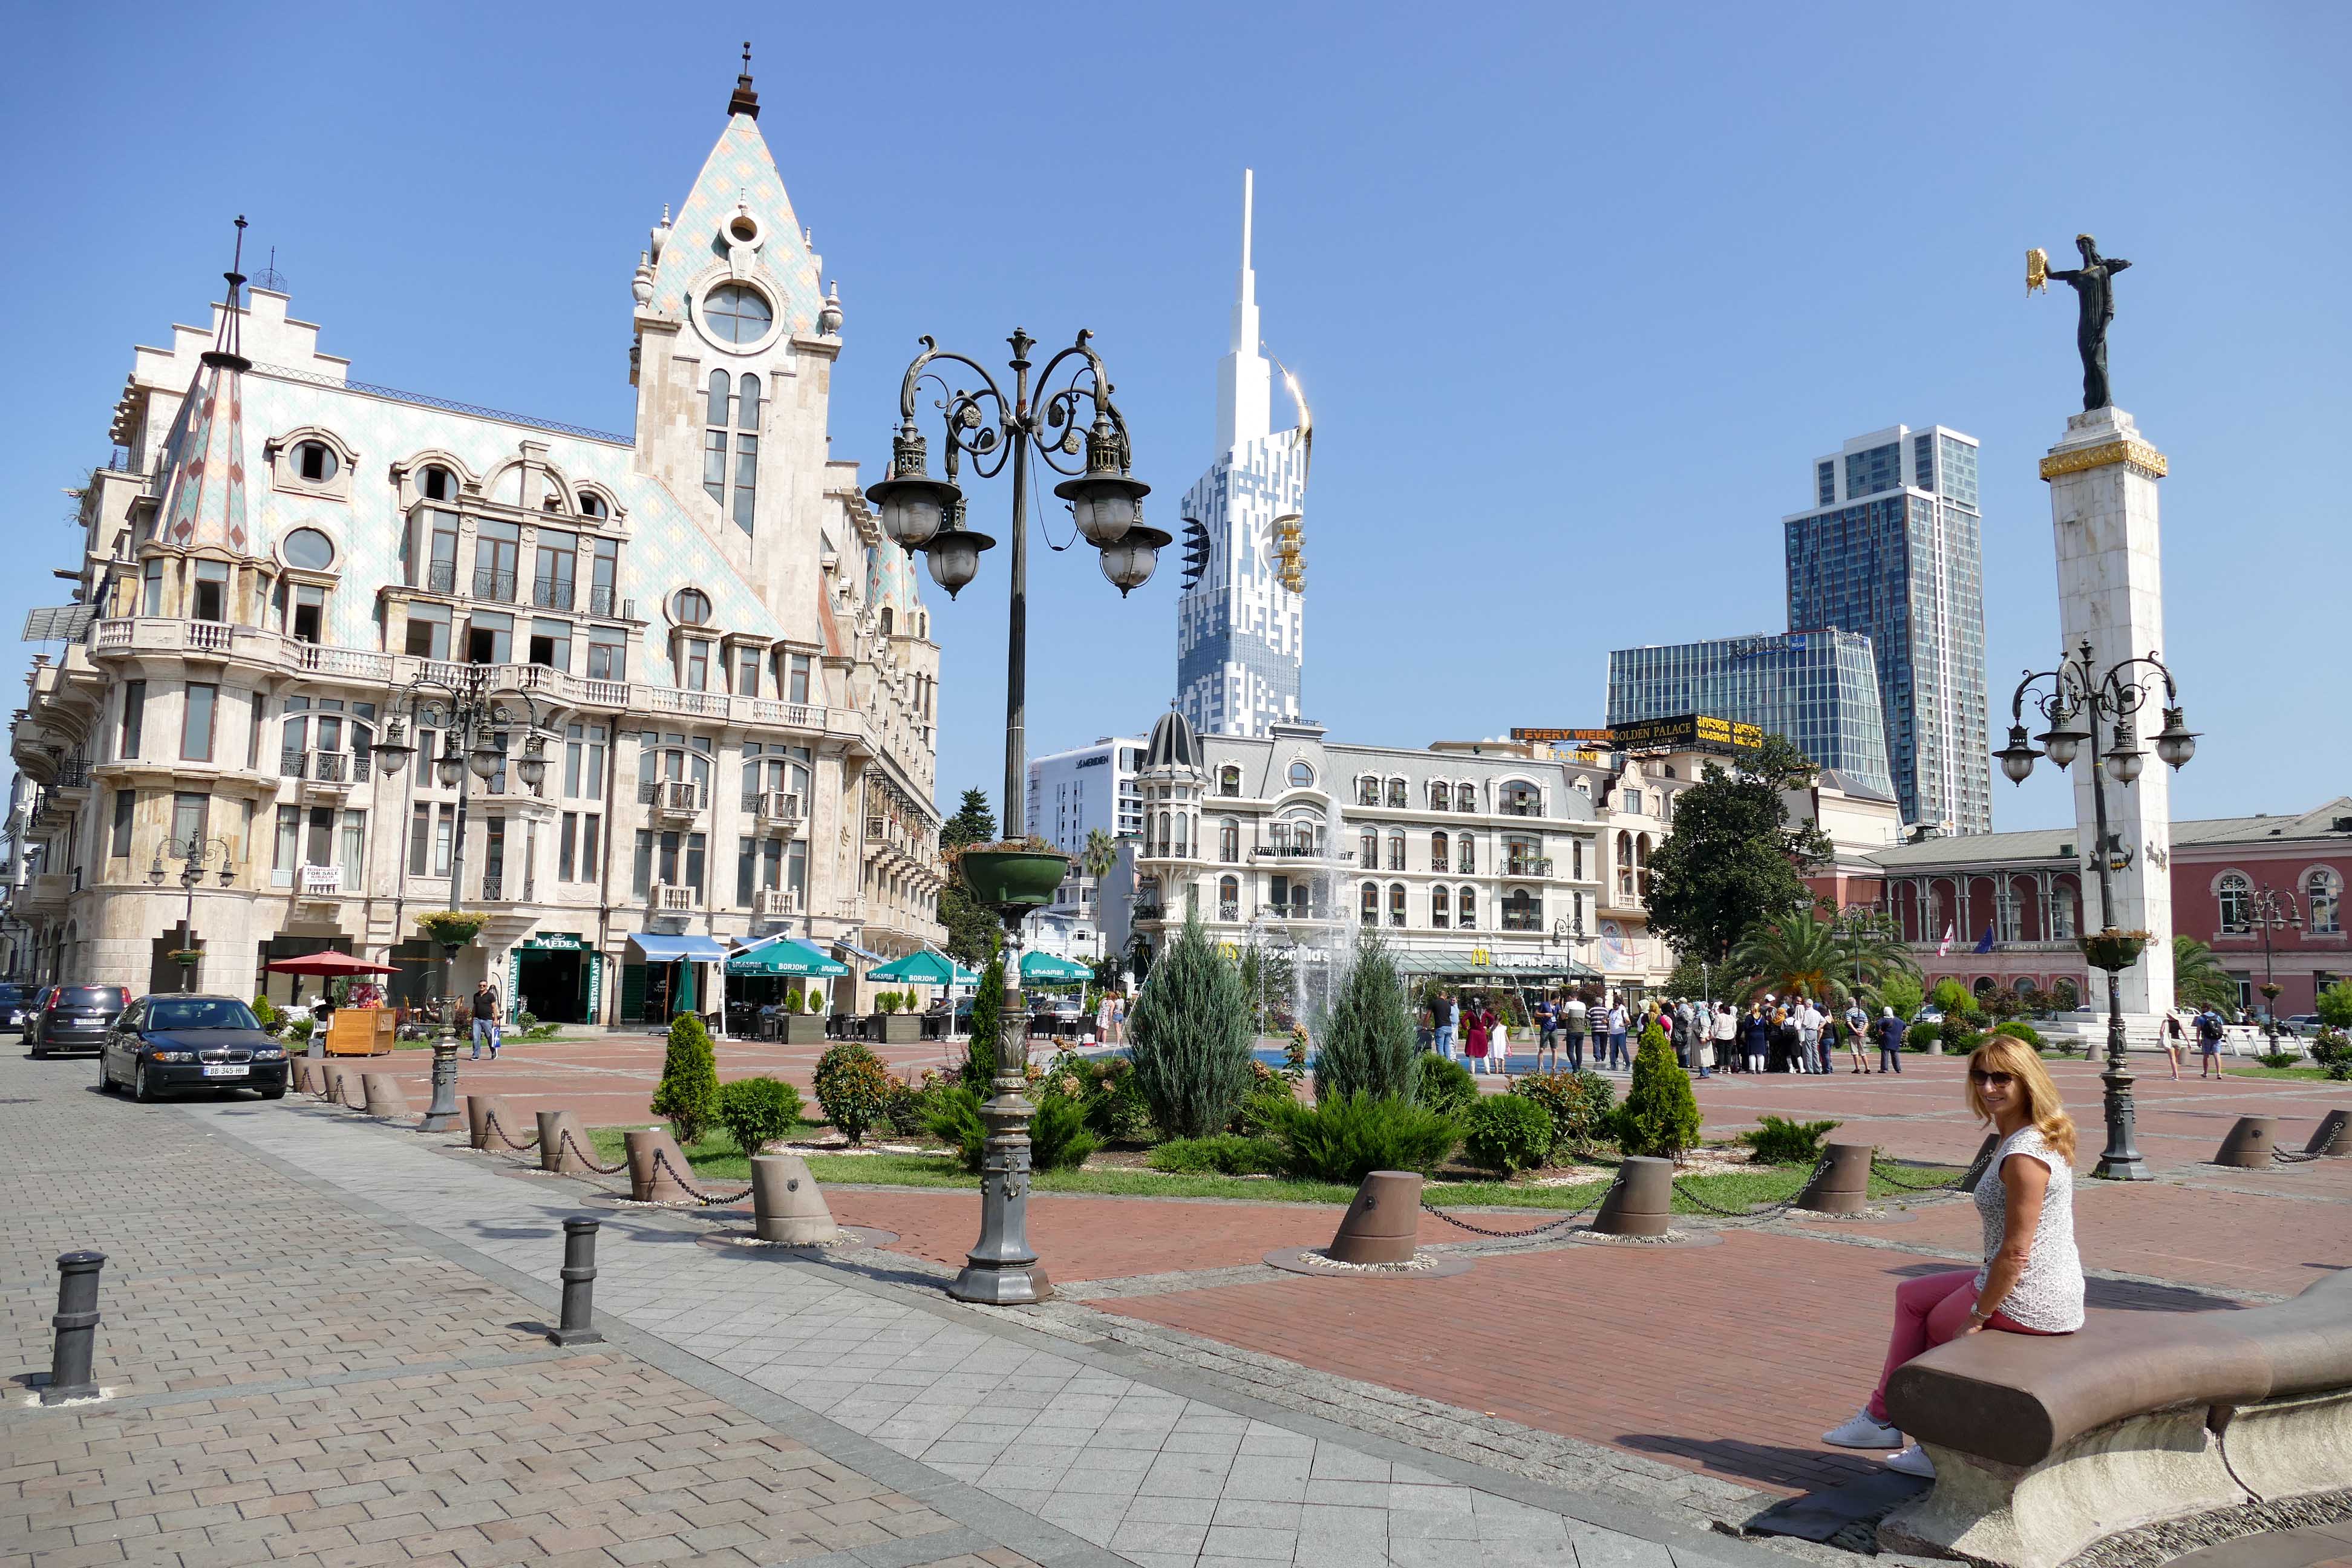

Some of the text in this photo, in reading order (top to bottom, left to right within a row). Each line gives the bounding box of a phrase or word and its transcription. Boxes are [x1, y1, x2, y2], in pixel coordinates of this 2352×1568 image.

[1524, 729, 1571, 739] EVERY
[1575, 730, 1616, 740] WEEK
[1653, 722, 1691, 737] PALACE
[1547, 750, 1599, 762] CASINO
[535, 937, 582, 950] MEDEA
